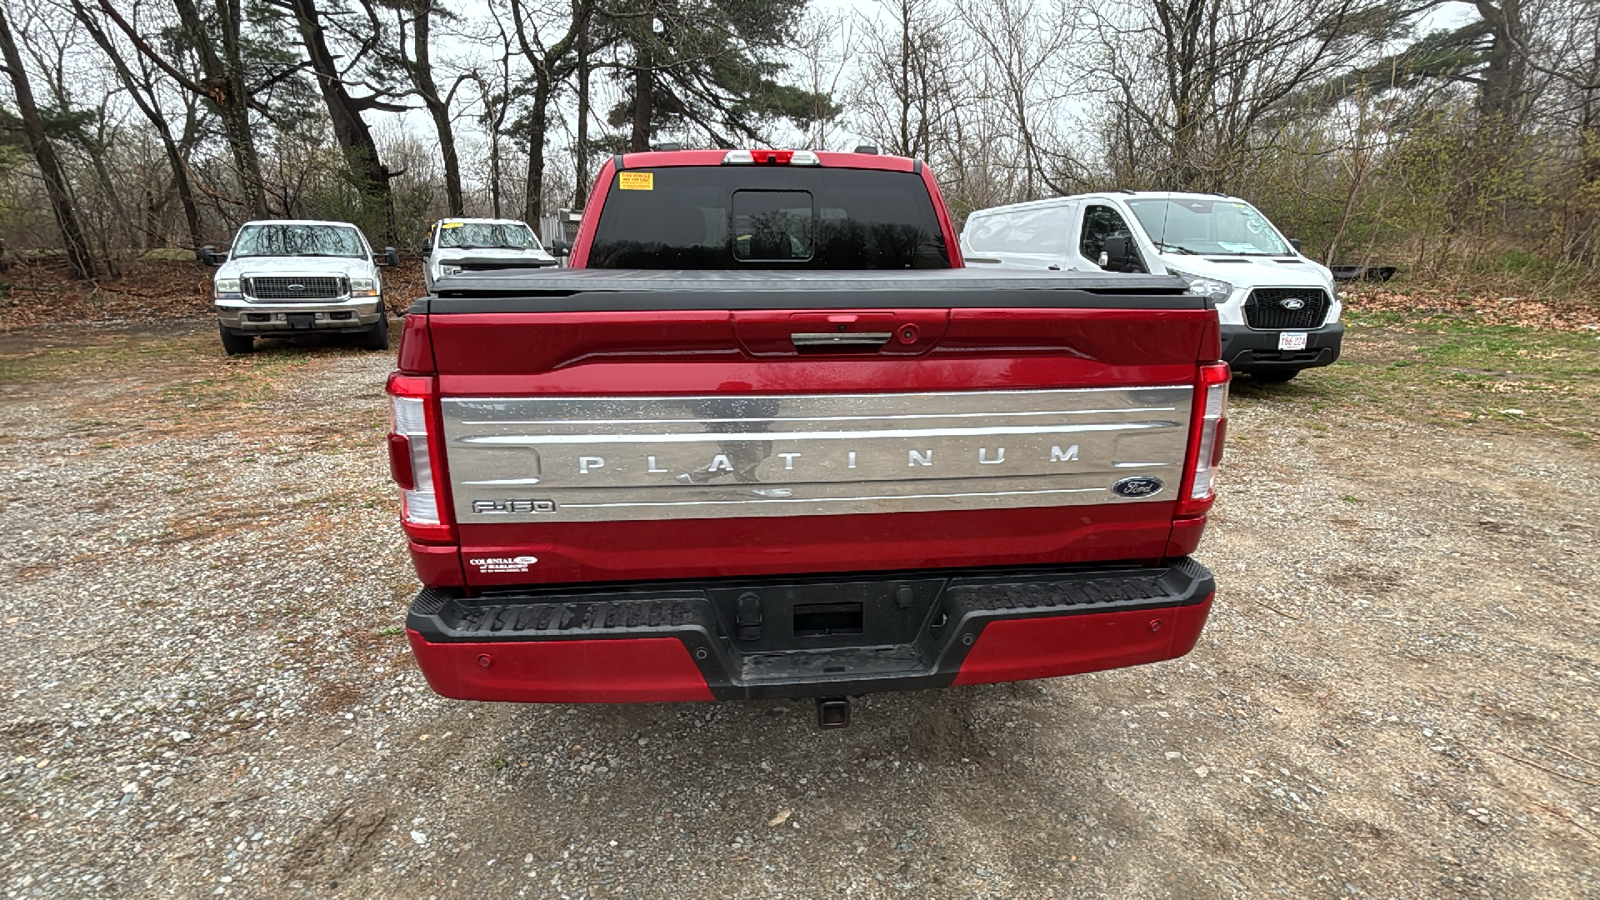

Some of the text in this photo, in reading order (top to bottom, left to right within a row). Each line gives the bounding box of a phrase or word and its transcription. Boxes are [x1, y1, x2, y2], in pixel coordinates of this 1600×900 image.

[579, 444, 1079, 475] PLATINUM
[1124, 481, 1153, 493] Ford
[472, 498, 556, 513] F-150
